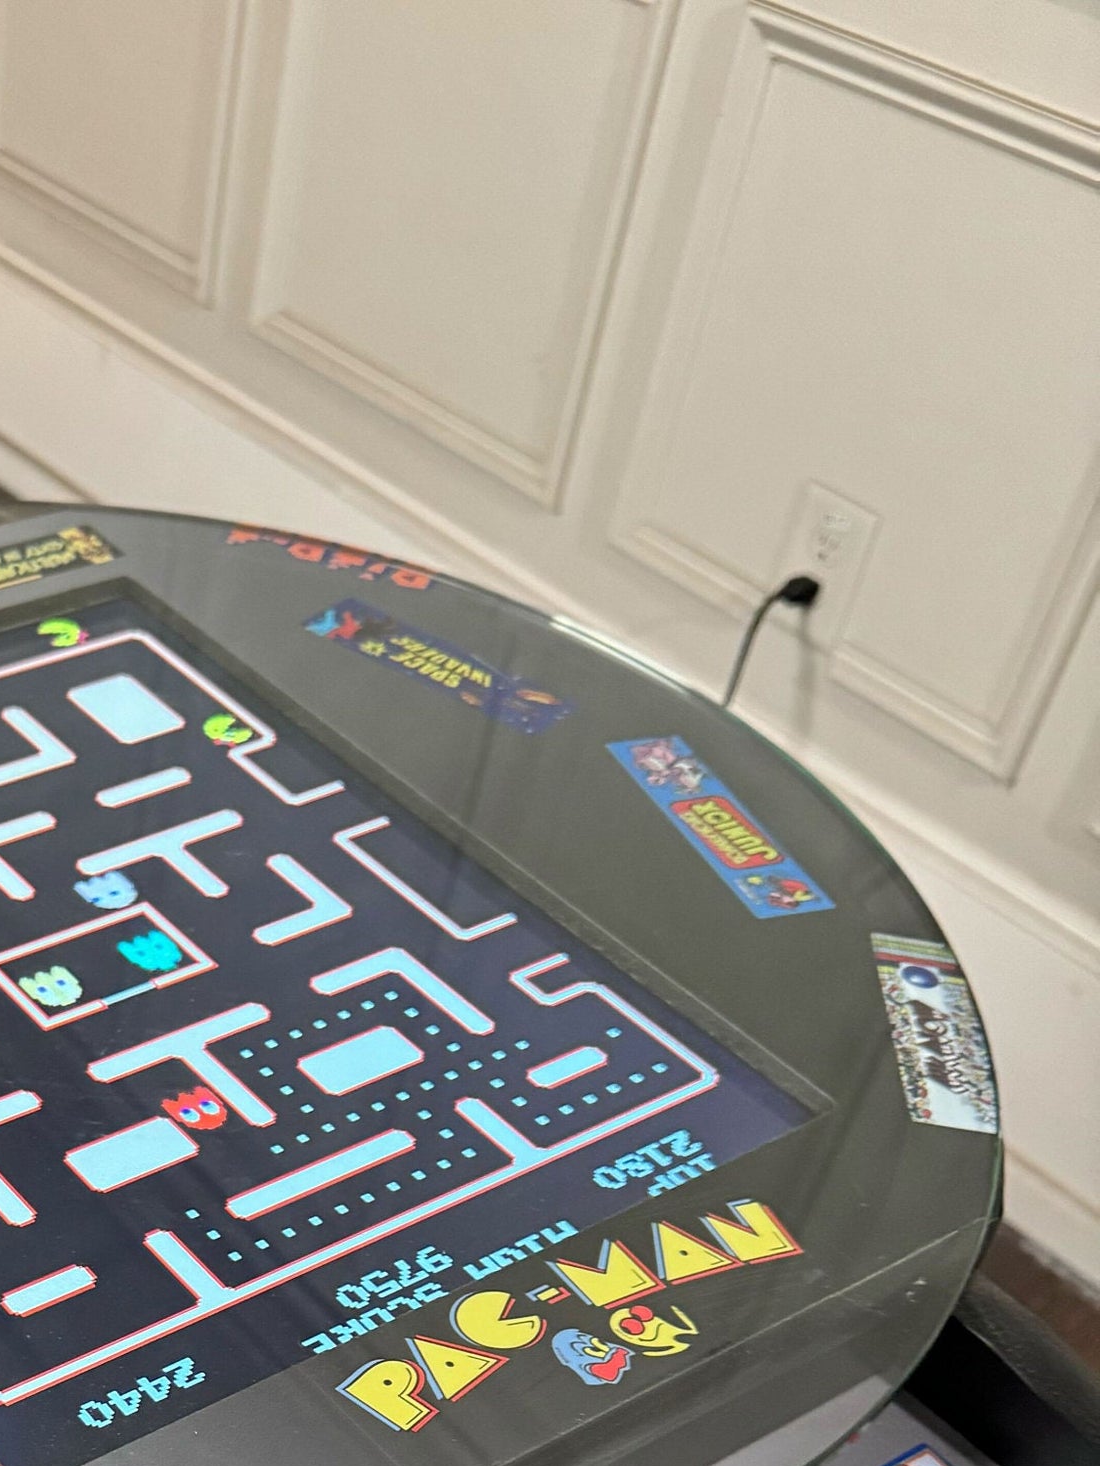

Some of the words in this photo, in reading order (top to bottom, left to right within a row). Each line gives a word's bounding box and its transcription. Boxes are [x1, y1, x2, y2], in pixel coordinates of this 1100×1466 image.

[389, 636, 492, 688] INVADERS
[389, 650, 462, 689] SPACE
[690, 800, 779, 862] JUNIOR
[592, 1129, 704, 1190] 2180
[336, 1246, 453, 1309] 9750
[335, 1197, 805, 1432] PAC-MAN
[77, 1357, 206, 1428] 2440
